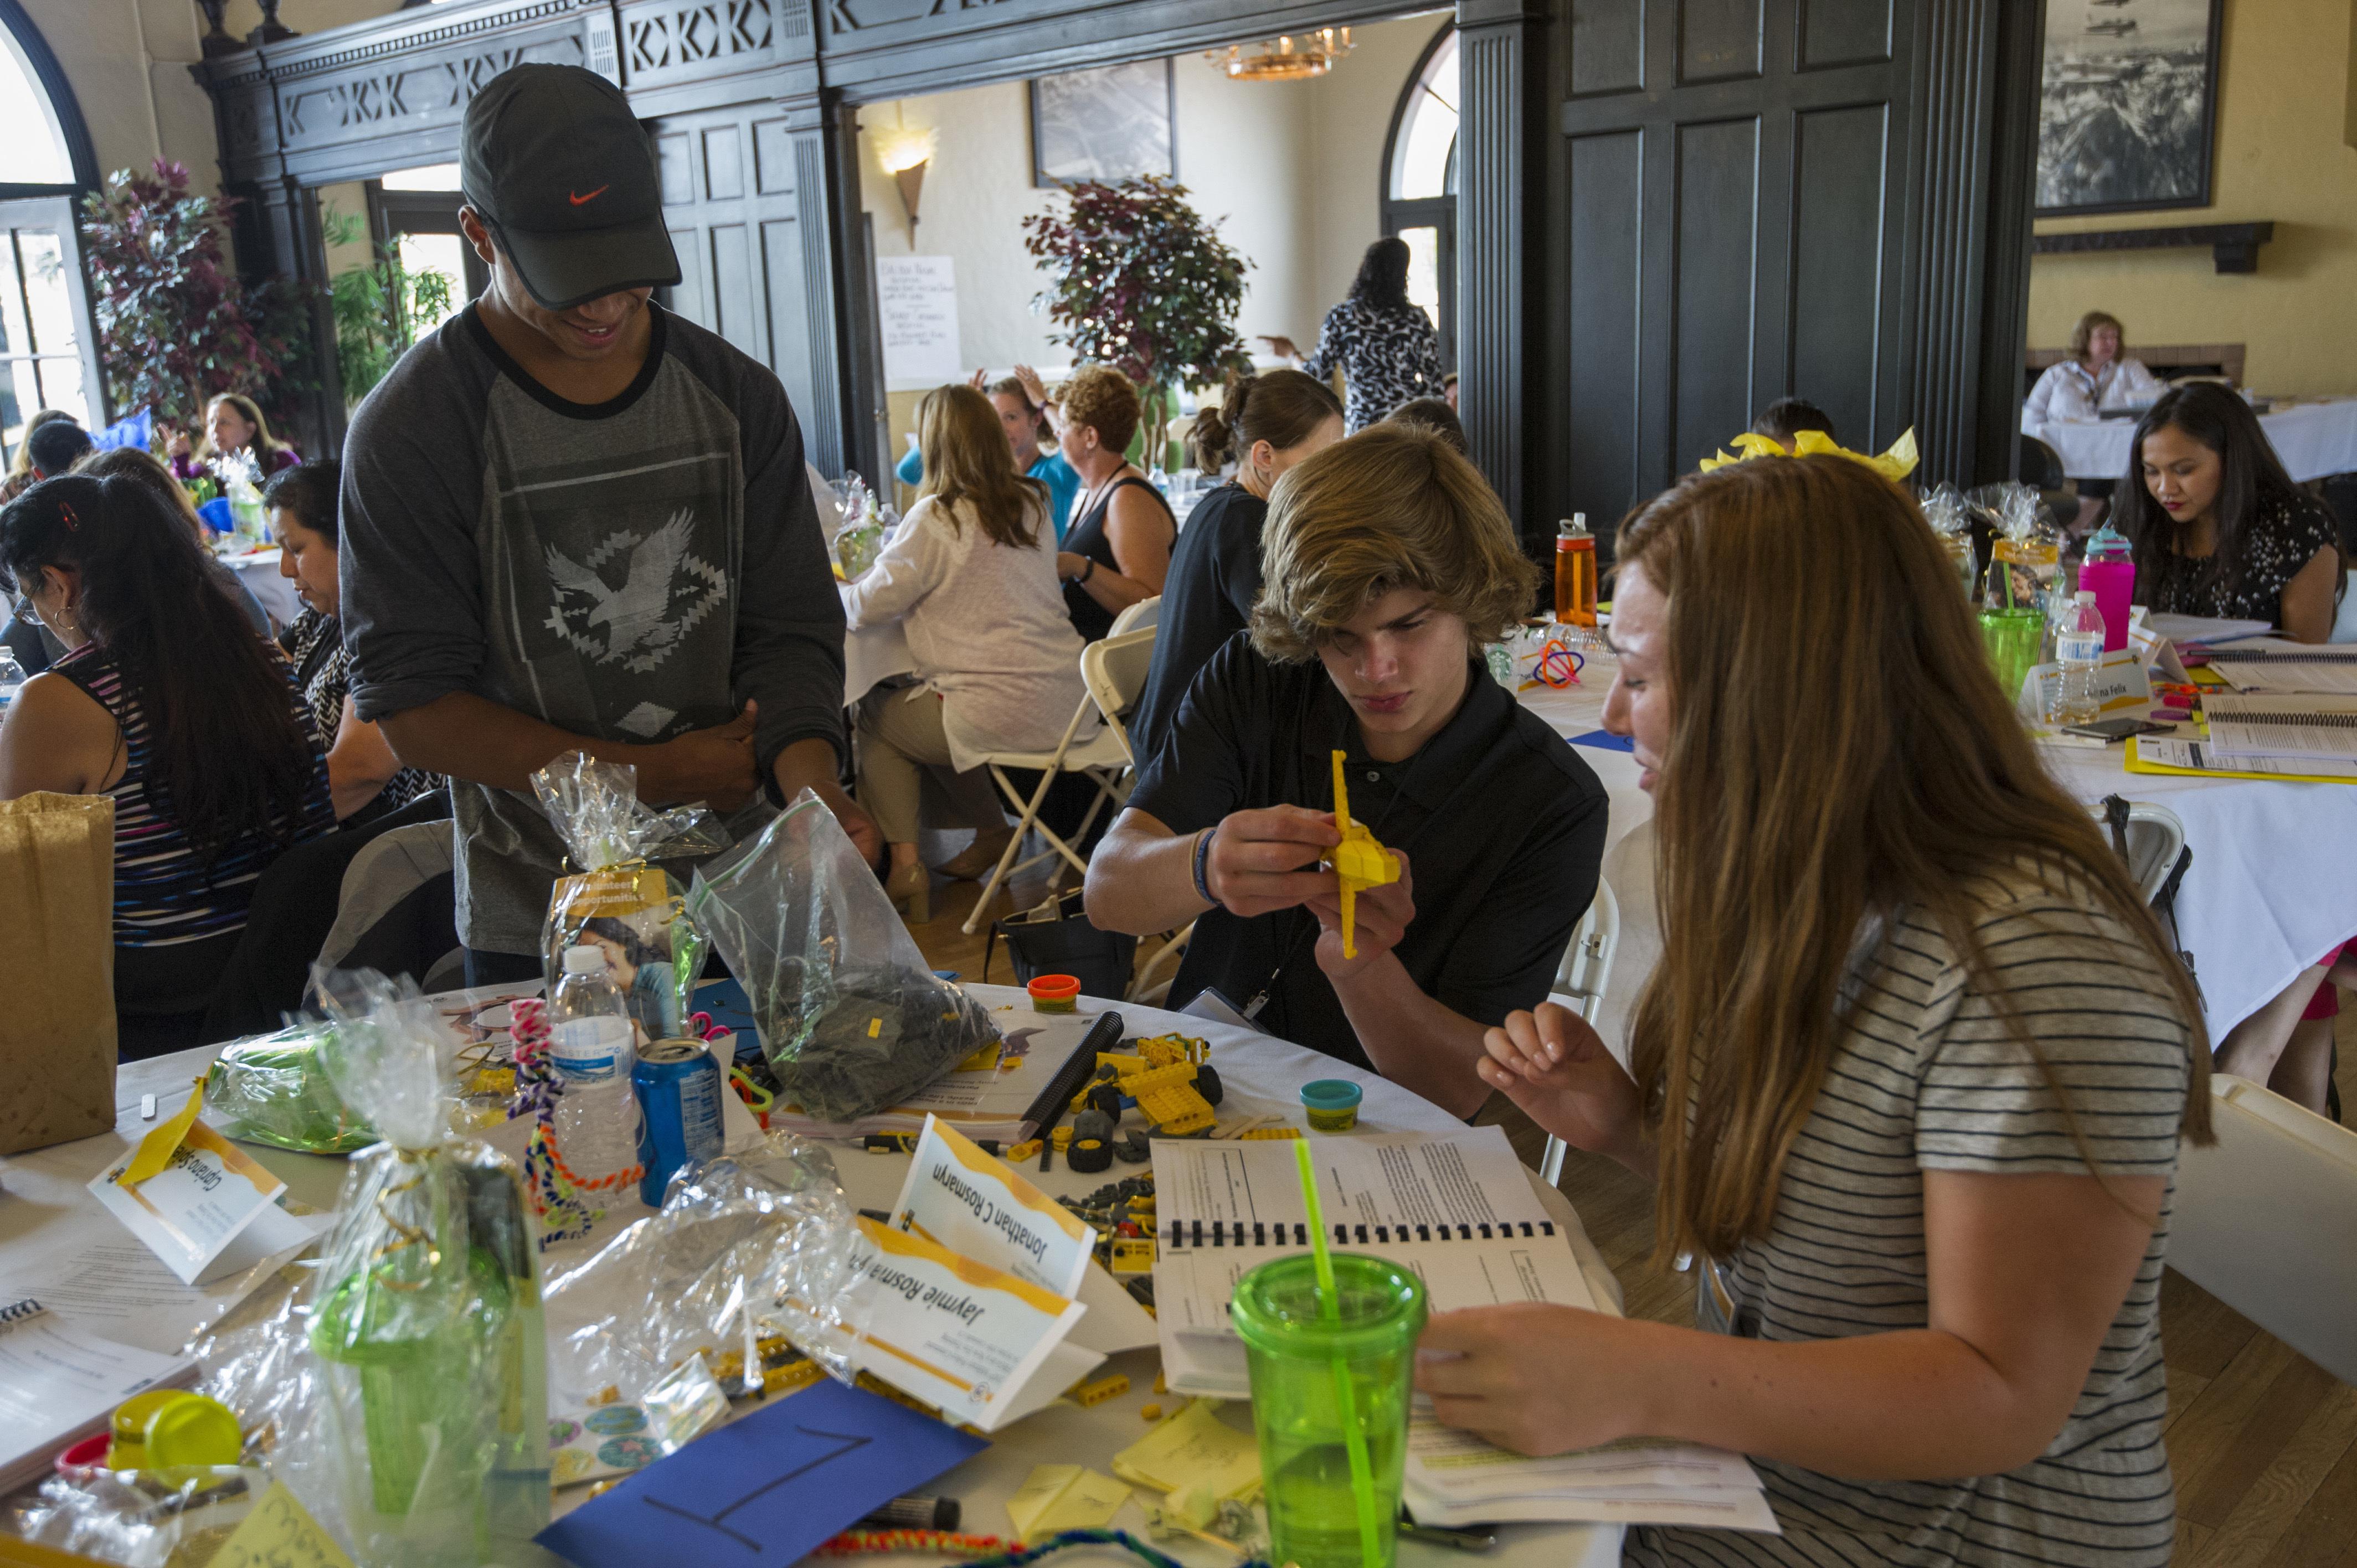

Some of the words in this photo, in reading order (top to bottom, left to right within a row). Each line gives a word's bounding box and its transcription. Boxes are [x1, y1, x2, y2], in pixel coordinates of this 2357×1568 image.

[2109, 683, 2127, 695] Felix
[572, 893, 645, 906] pportunities
[187, 1159, 222, 1191] Cipriano
[933, 1163, 985, 1216] Rosmaryn
[982, 1201, 994, 1223] C
[994, 1208, 1048, 1263] Jonathan
[848, 1254, 925, 1299] Rosmayn
[923, 1286, 985, 1325] Jaymie
